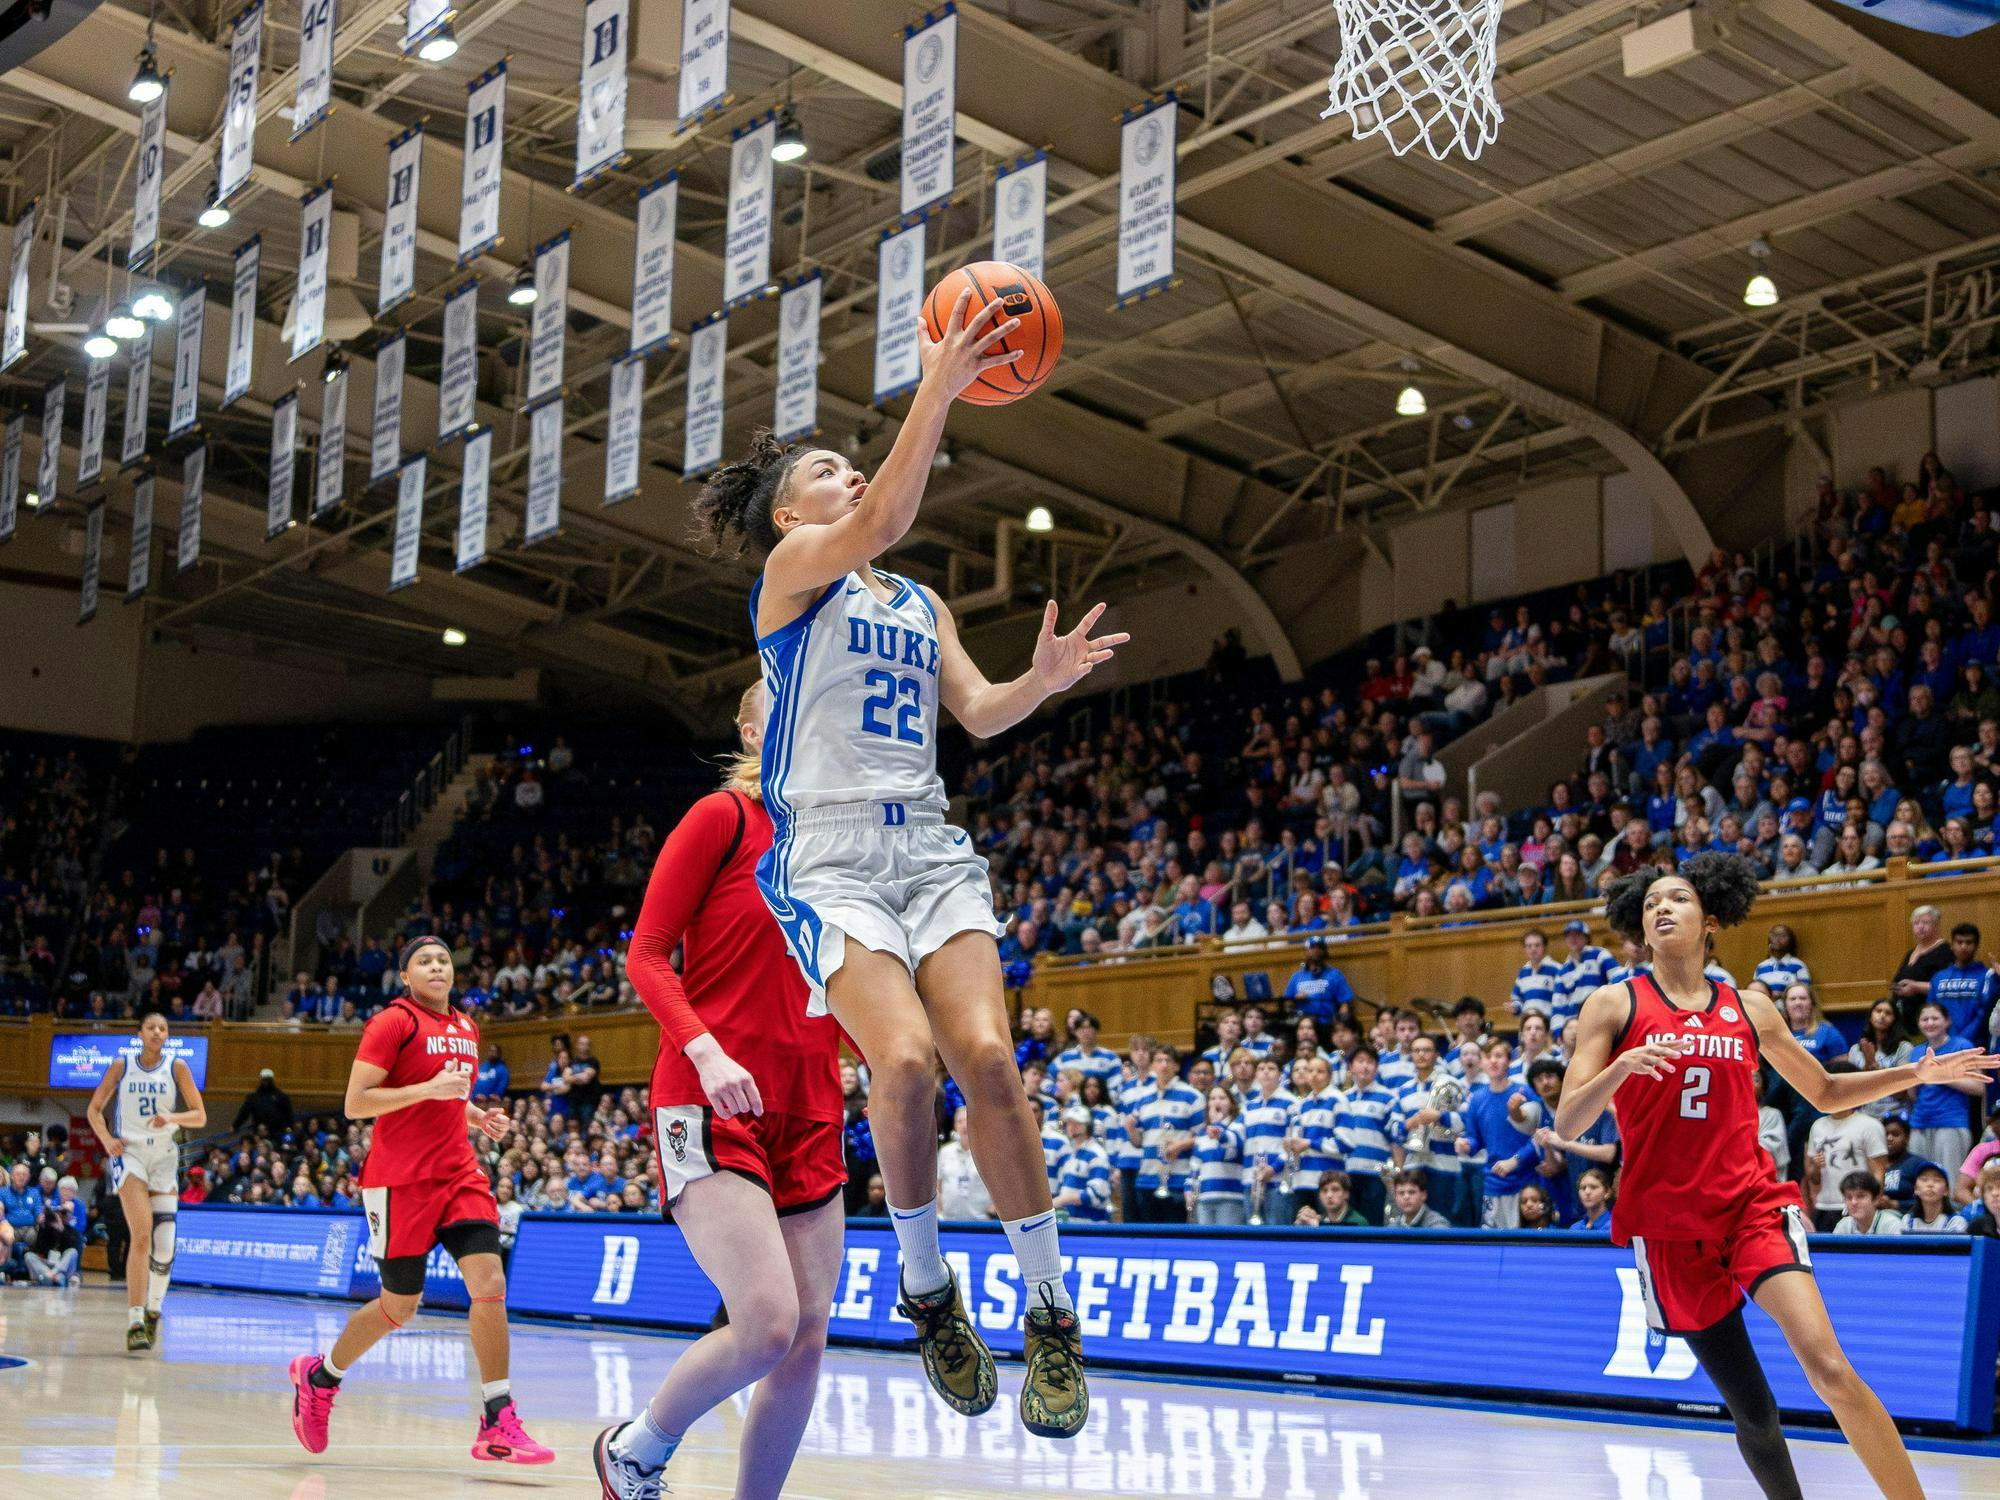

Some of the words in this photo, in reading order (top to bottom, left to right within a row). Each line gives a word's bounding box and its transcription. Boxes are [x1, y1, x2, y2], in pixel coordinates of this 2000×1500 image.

[848, 617, 940, 677] DUKE
[862, 669, 923, 746] 22
[427, 1036, 447, 1055] NC
[448, 1037, 478, 1059] STATE
[1681, 1033, 1744, 1061] STATE
[129, 1082, 167, 1094] DUKE
[1679, 1066, 1711, 1119] 2
[139, 1097, 157, 1116] 21
